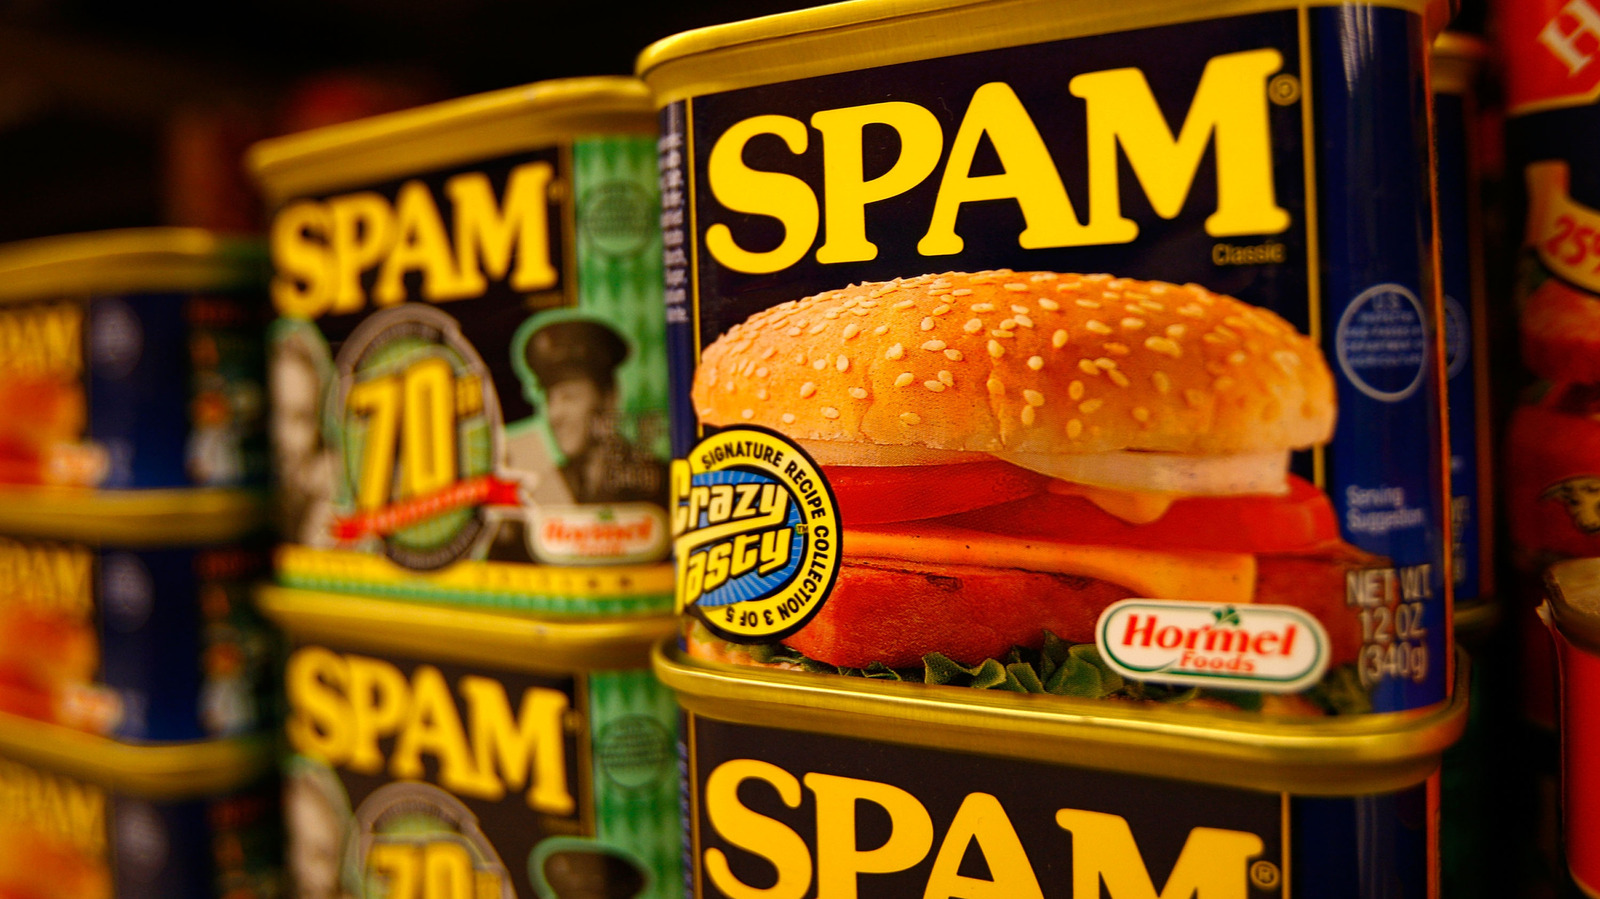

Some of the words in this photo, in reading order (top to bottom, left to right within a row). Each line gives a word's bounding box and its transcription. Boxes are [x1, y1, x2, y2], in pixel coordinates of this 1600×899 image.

[705, 48, 1290, 274] SPAM
[270, 161, 558, 319] SPAM
[1212, 240, 1287, 266] Classic
[702, 441, 784, 469] SIGNATURE
[671, 459, 789, 536] Crazy
[785, 460, 826, 519] RECIPE
[1346, 485, 1404, 507] Serving
[1346, 508, 1425, 533] Suggestion
[777, 525, 829, 620] COLLECTION
[1346, 569, 1395, 606] NET
[726, 607, 735, 623] 5
[740, 612, 758, 627] OF
[764, 610, 774, 625] 3
[1359, 606, 1392, 642] 12
[1395, 602, 1427, 638] OZ
[1122, 614, 1298, 656] Hormel
[1179, 650, 1255, 674] Foods
[1358, 641, 1428, 687] (340g)
[286, 646, 576, 815] SPAM
